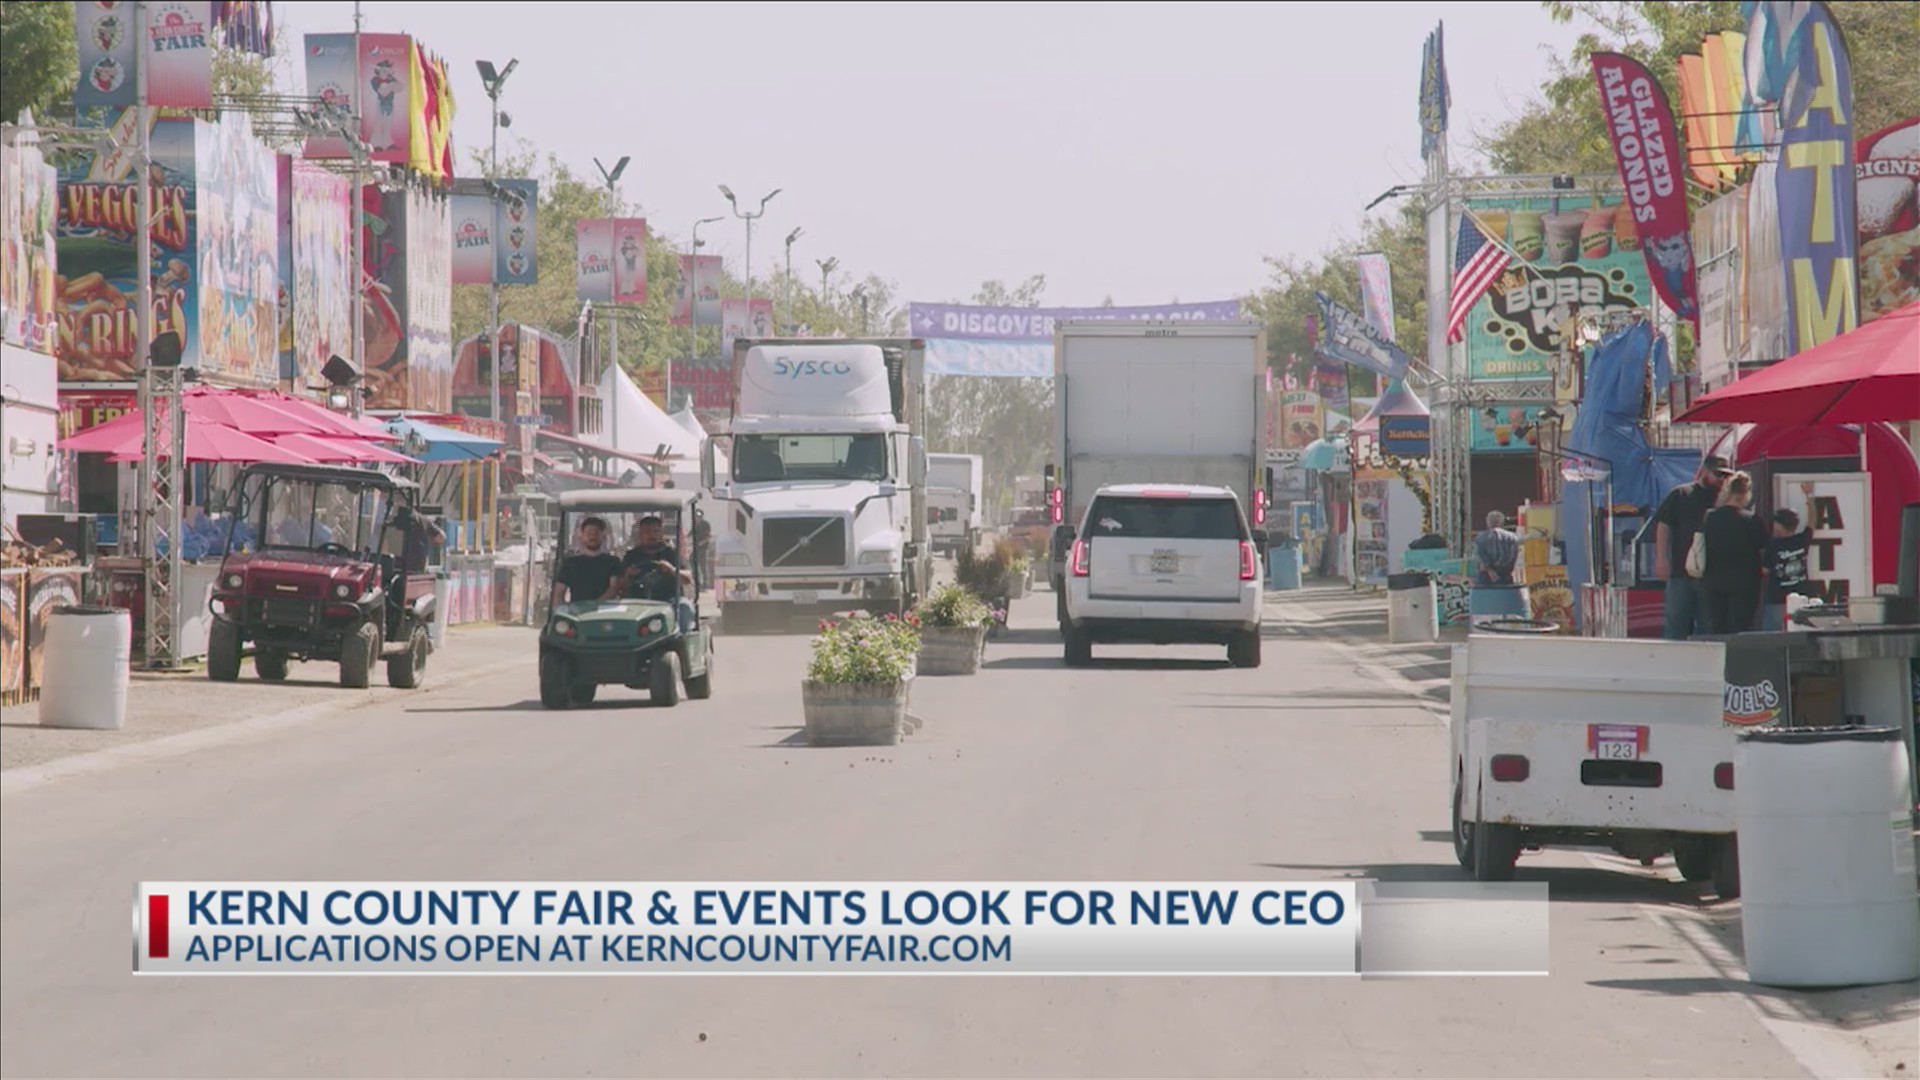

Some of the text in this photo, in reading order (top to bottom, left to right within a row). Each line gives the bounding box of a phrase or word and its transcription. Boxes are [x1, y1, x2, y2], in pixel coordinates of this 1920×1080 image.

[153, 35, 206, 51] FAIR
[1601, 66, 1656, 223] ALMONDS
[1631, 77, 1674, 197] GLAZED
[1787, 21, 1857, 352] ATM
[944, 312, 1056, 335] DISCOVER
[774, 356, 851, 379] Sysco
[1485, 360, 1540, 374] DRINKS
[1810, 496, 1850, 616] ATM
[1604, 743, 1632, 758] 123
